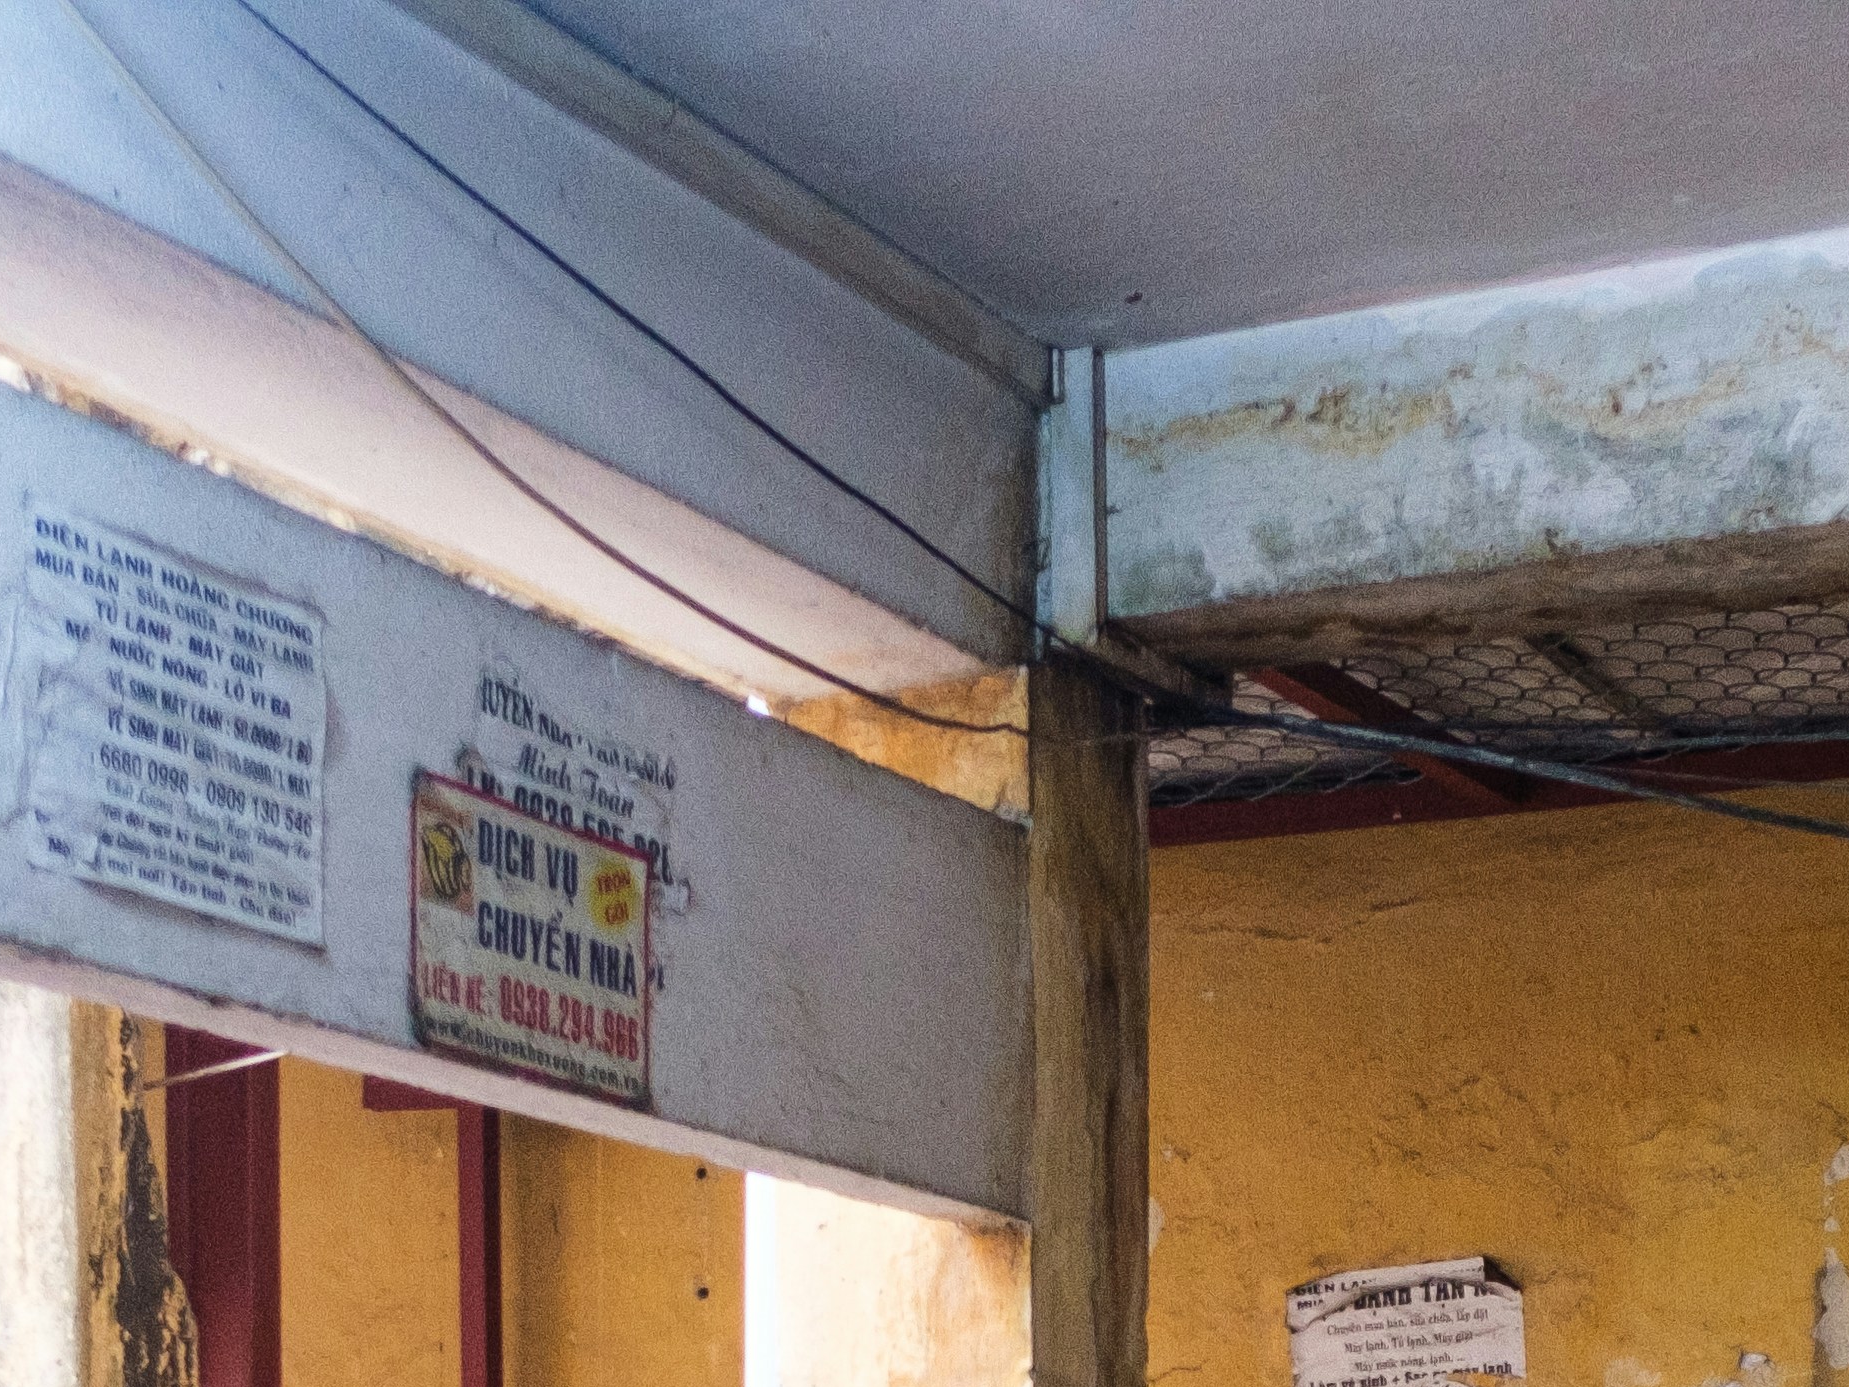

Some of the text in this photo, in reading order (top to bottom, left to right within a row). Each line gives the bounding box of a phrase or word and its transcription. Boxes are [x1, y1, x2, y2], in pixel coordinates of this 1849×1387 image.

[35, 549, 75, 576] MUA
[478, 819, 535, 880] DỊCH
[545, 845, 578, 905] VỤ
[477, 902, 637, 996] CHUYỂN NHÀ
